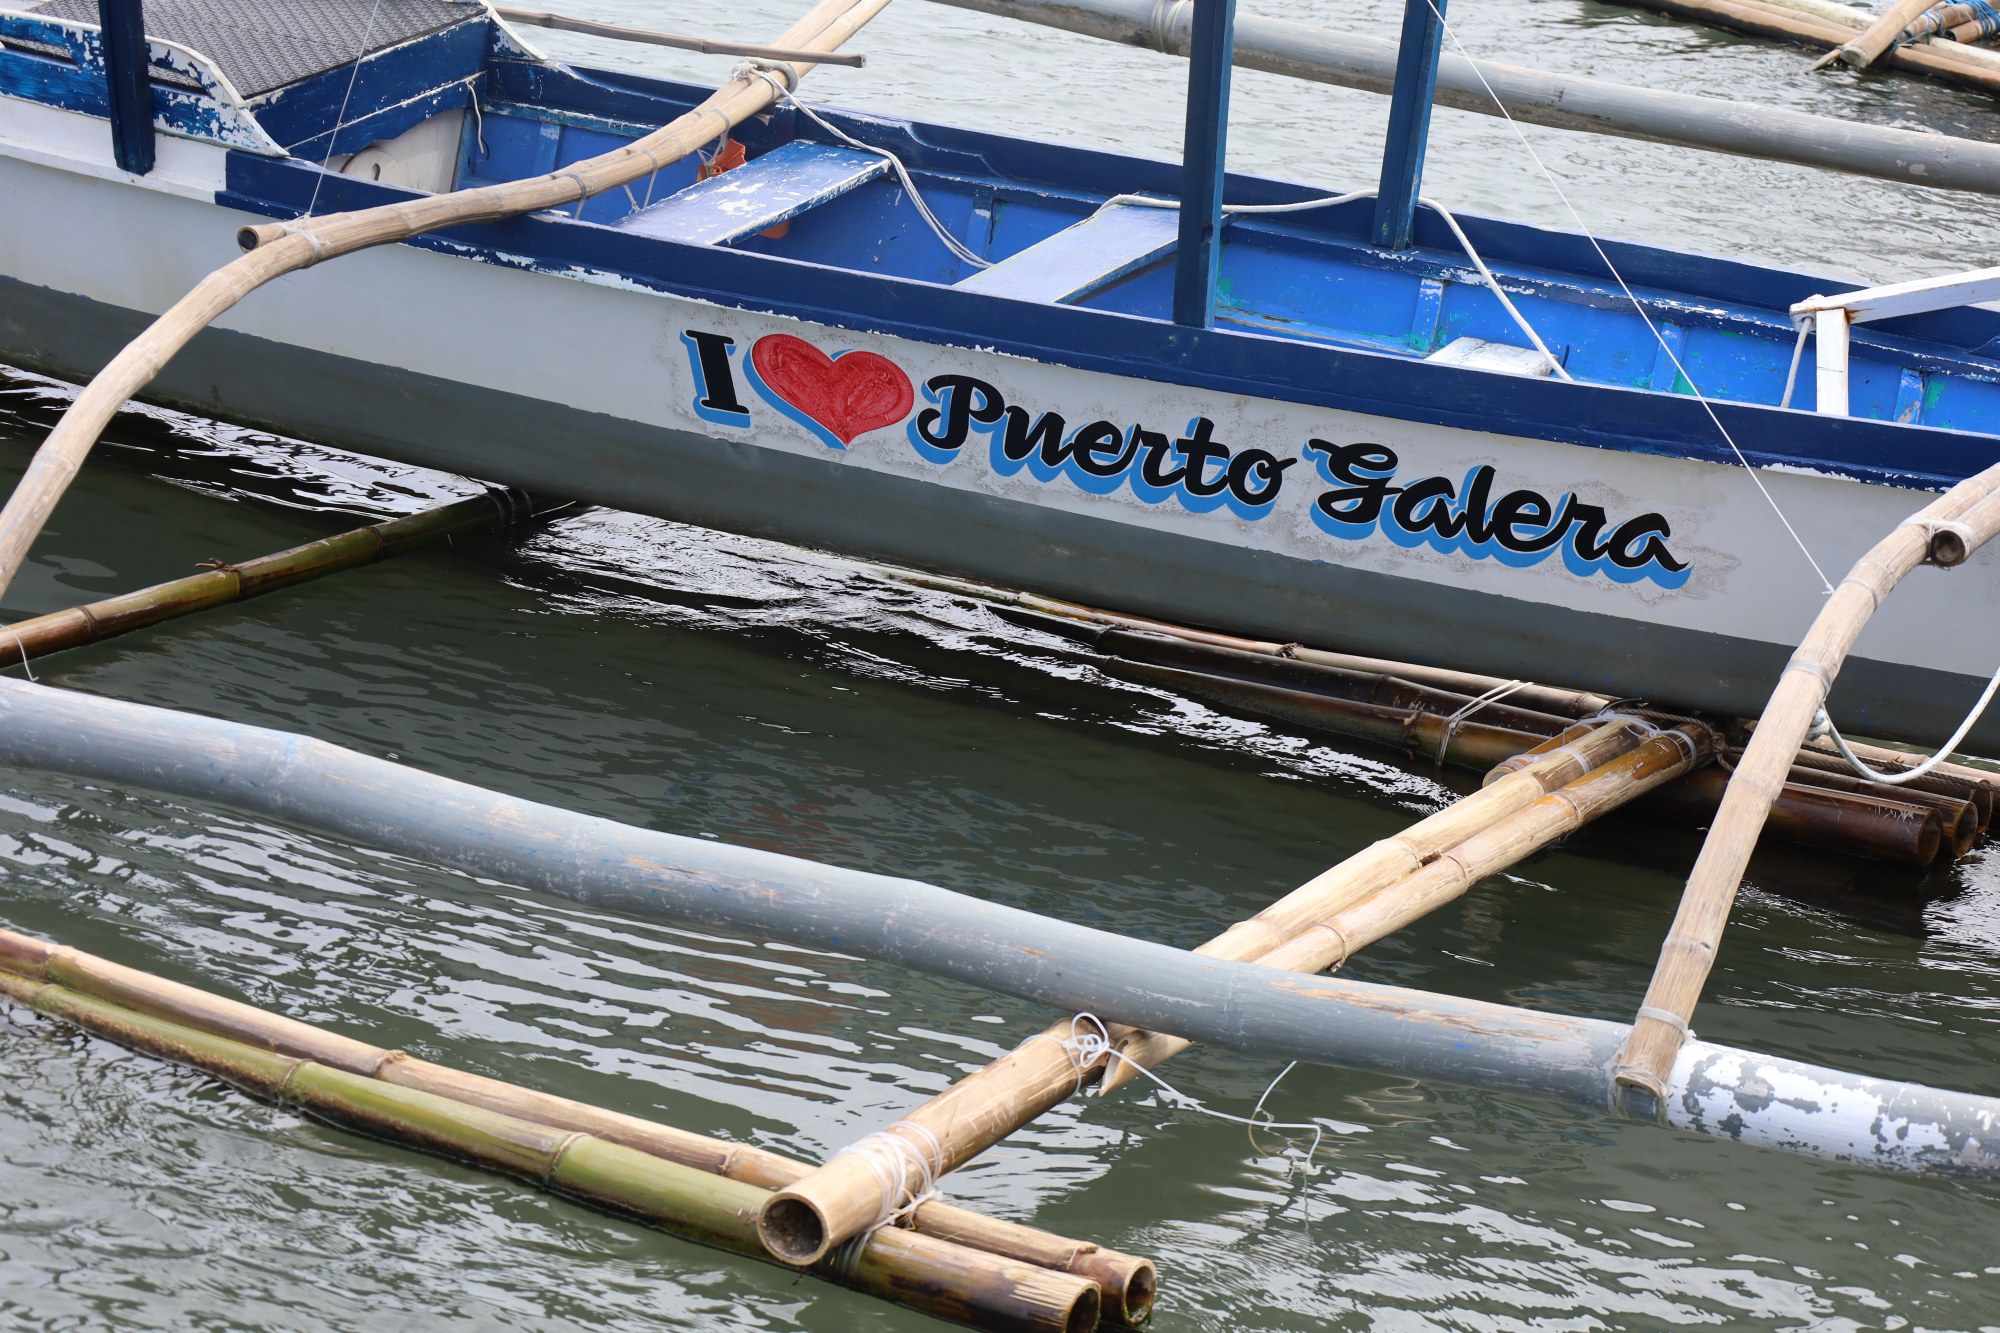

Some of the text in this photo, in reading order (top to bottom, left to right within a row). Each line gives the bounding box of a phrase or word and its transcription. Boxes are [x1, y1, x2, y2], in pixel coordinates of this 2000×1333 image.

[683, 329, 1690, 581] I Puerto Galera
